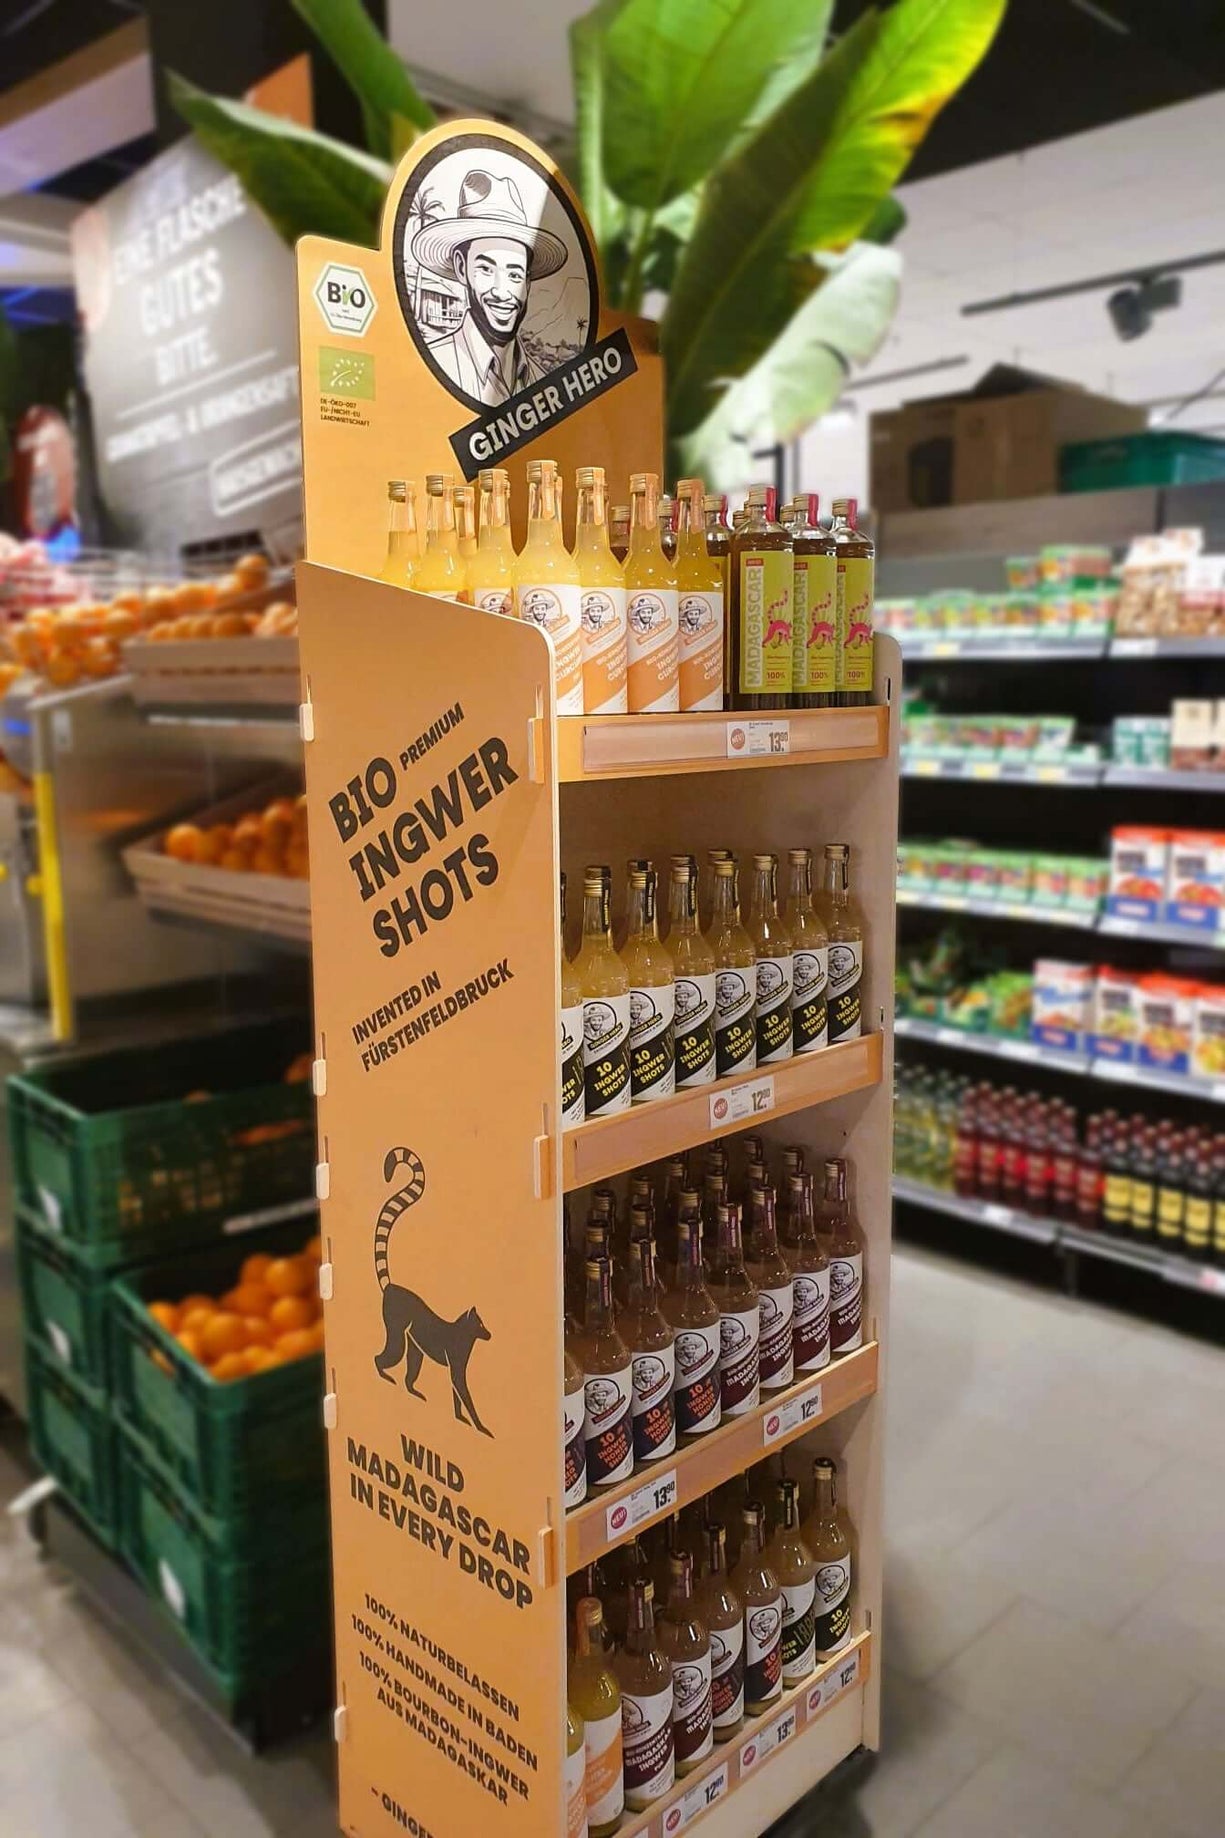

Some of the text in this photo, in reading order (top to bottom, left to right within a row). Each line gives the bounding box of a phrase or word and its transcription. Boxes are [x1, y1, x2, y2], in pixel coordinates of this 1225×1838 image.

[468, 347, 622, 461] GINGER HERO
[747, 568, 762, 686] MADAGASCAR
[328, 702, 464, 843] BIO PREMIUM
[349, 737, 519, 902] INGWER
[372, 833, 499, 958] SHOTS
[352, 970, 441, 1045] INVENTED IN
[361, 958, 514, 1072] FÜRSTENFELDBRUCK
[635, 1050, 651, 1064] 10
[682, 1036, 697, 1051] 10
[594, 1064, 626, 1091] INGWER
[597, 1062, 612, 1077] 10
[602, 1075, 626, 1096] SHOTS
[633, 1053, 665, 1077] INGWER
[640, 1063, 665, 1084] SHOTS
[347, 1436, 530, 1575] MADAGASCAR
[400, 1433, 464, 1493] WILD
[653, 1481, 675, 1510] 13.90
[349, 1472, 533, 1610] IN EVERY DROP
[365, 1593, 519, 1722] 100% NATURBELASSEN
[831, 1609, 843, 1623] 10
[351, 1614, 538, 1772] 100% HANDMADE IN BADEN
[359, 1651, 529, 1800] 100% BOURBON-INGWER
[376, 1687, 403, 1718] AUS
[405, 1712, 509, 1807] MADAGASKAR
